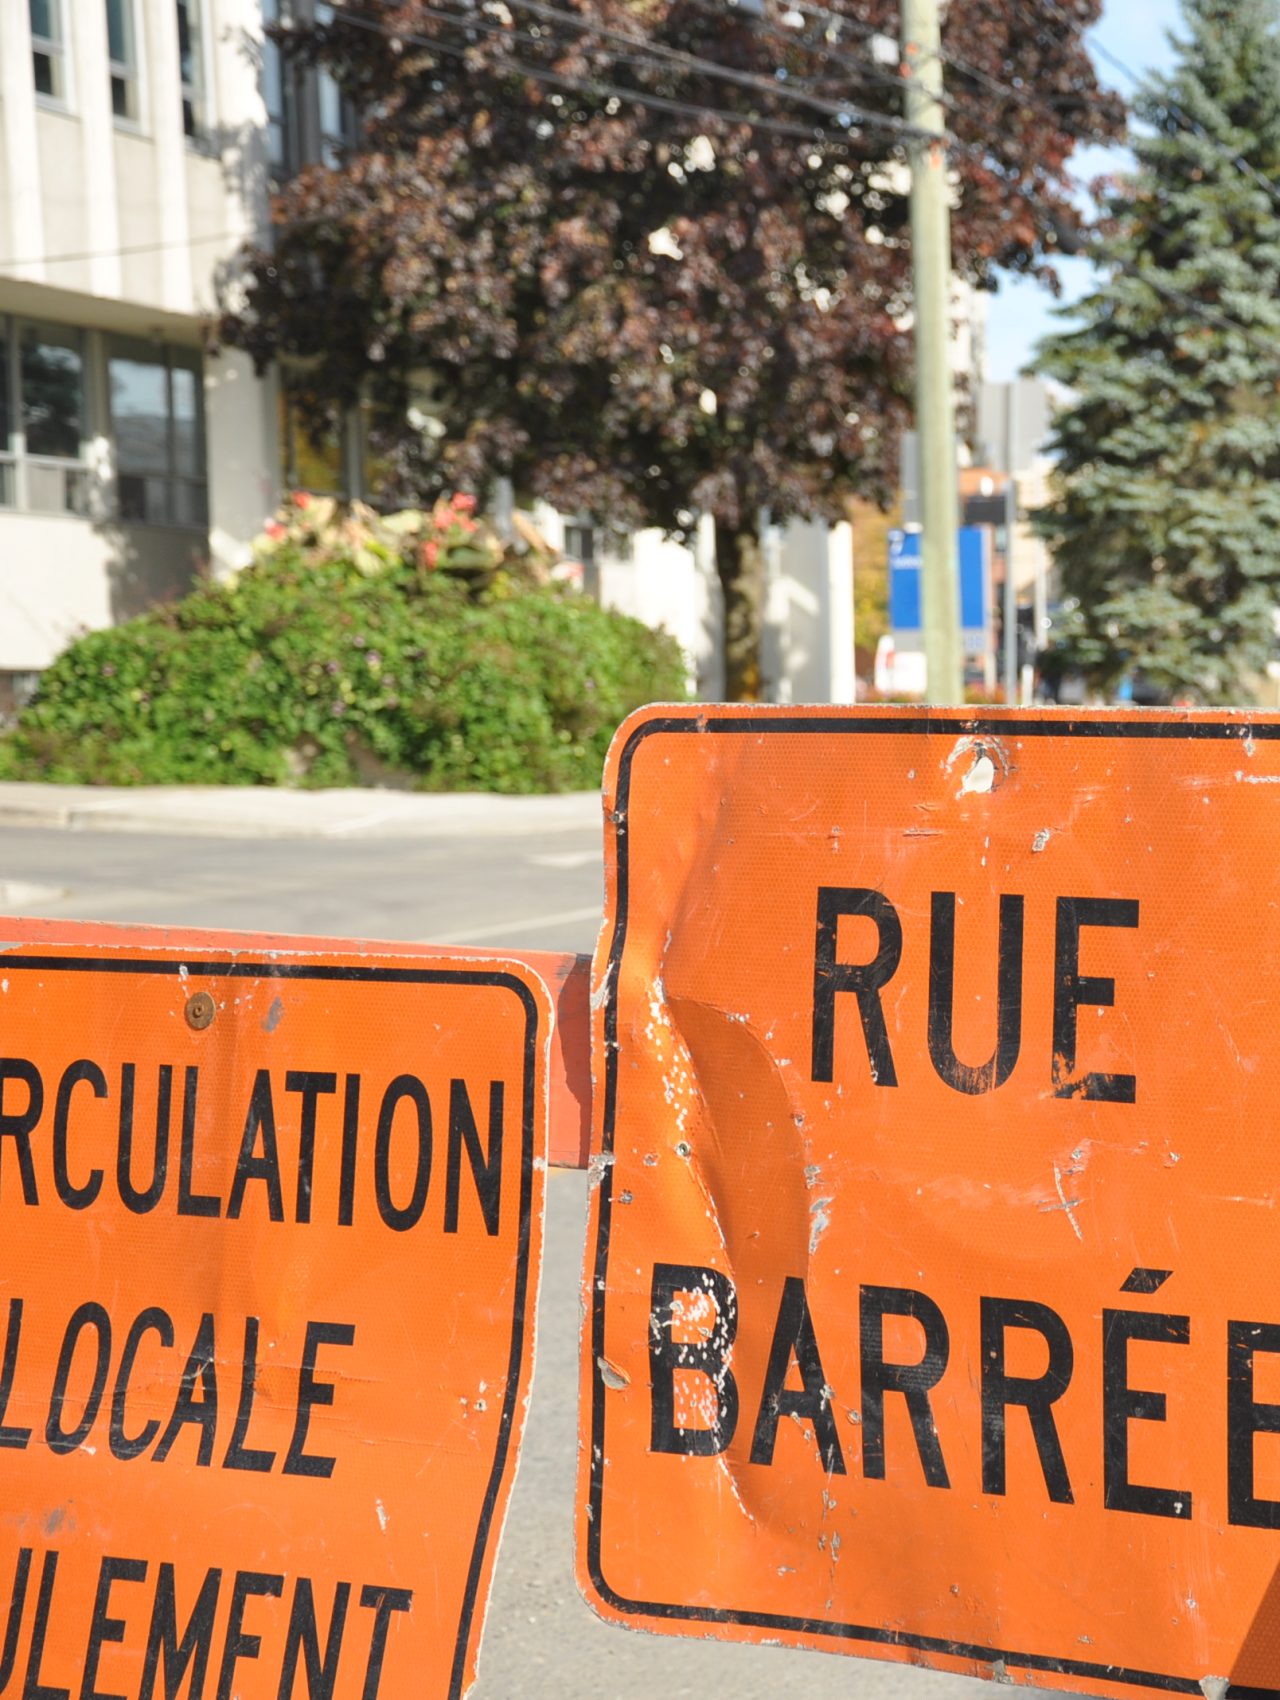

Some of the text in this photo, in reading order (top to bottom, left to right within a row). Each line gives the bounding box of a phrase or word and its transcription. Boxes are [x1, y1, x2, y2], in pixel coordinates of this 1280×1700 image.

[811, 885, 1139, 1104] RUE
[0, 1058, 504, 1236] RCULATION
[0, 1298, 355, 1478] LOCALE
